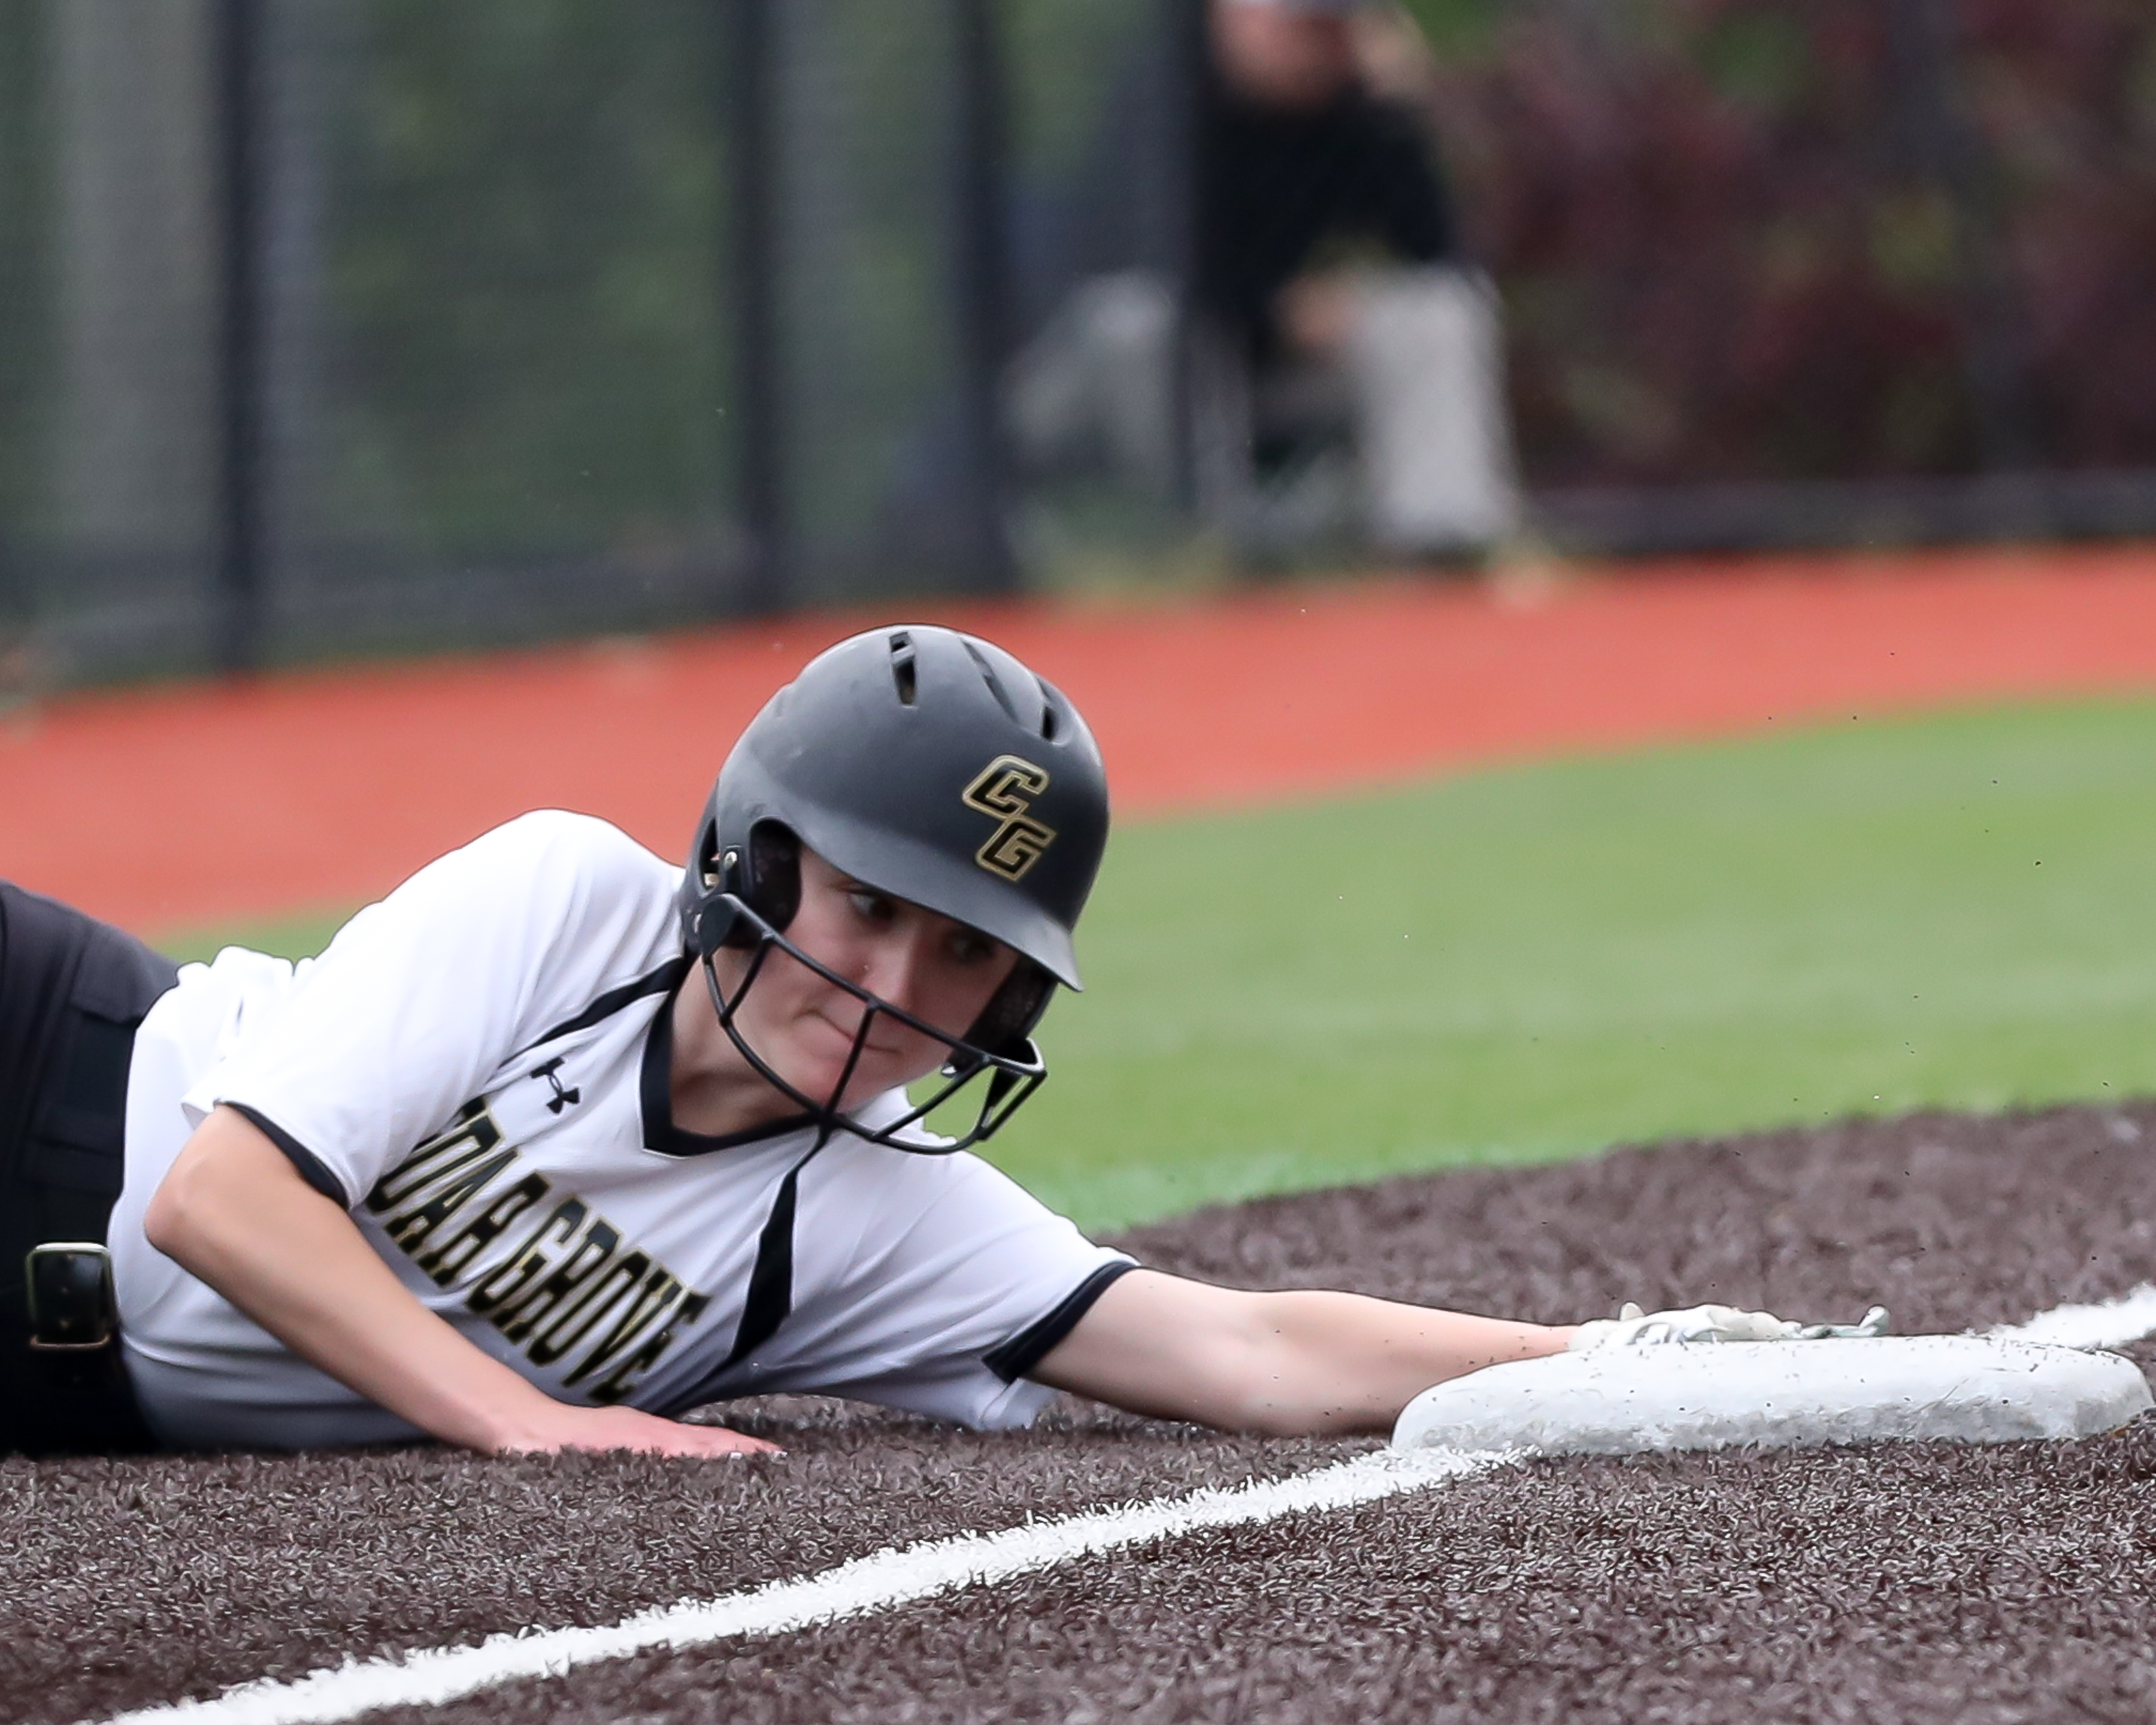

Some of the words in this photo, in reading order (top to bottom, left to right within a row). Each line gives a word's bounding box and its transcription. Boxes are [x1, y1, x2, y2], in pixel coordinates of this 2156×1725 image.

[962, 754, 1057, 881] CG
[362, 1094, 553, 1289] DAR
[464, 1194, 713, 1404] GROVE
